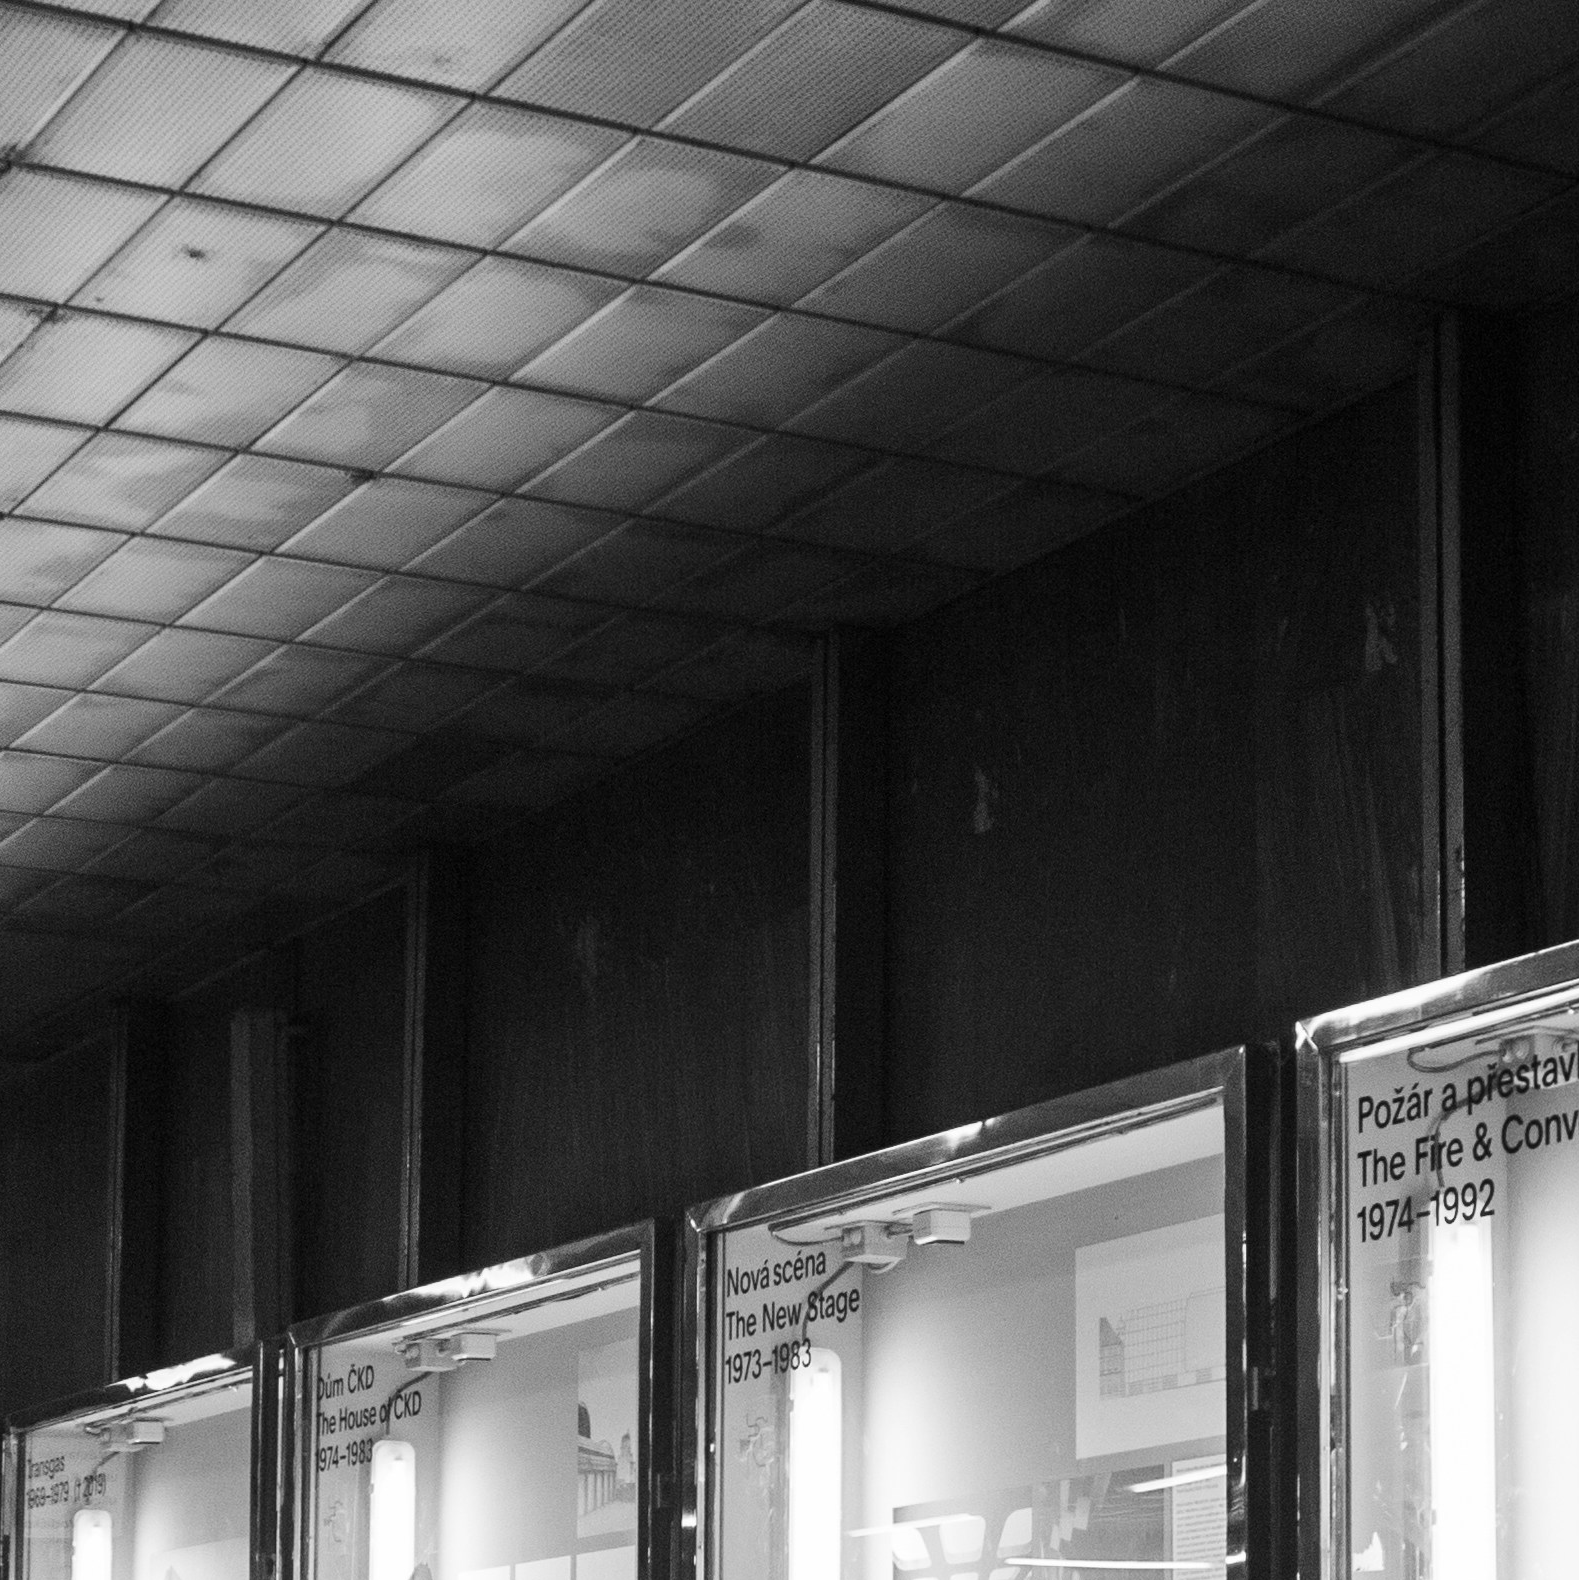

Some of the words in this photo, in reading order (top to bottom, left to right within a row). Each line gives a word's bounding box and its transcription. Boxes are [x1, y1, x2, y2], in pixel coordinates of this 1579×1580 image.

[1357, 1082, 1433, 1134] Požár
[1441, 1082, 1458, 1113] a
[1357, 1148, 1406, 1188] The
[1415, 1130, 1464, 1176] Fire
[1472, 1121, 1493, 1162] &
[726, 1259, 770, 1298] Nová
[772, 1250, 826, 1286] scéna
[725, 1310, 757, 1341] The
[762, 1301, 802, 1333] New
[807, 1288, 860, 1323] Stage
[347, 1363, 375, 1394] ČKD
[339, 1406, 377, 1432] House
[379, 1396, 392, 1424] of
